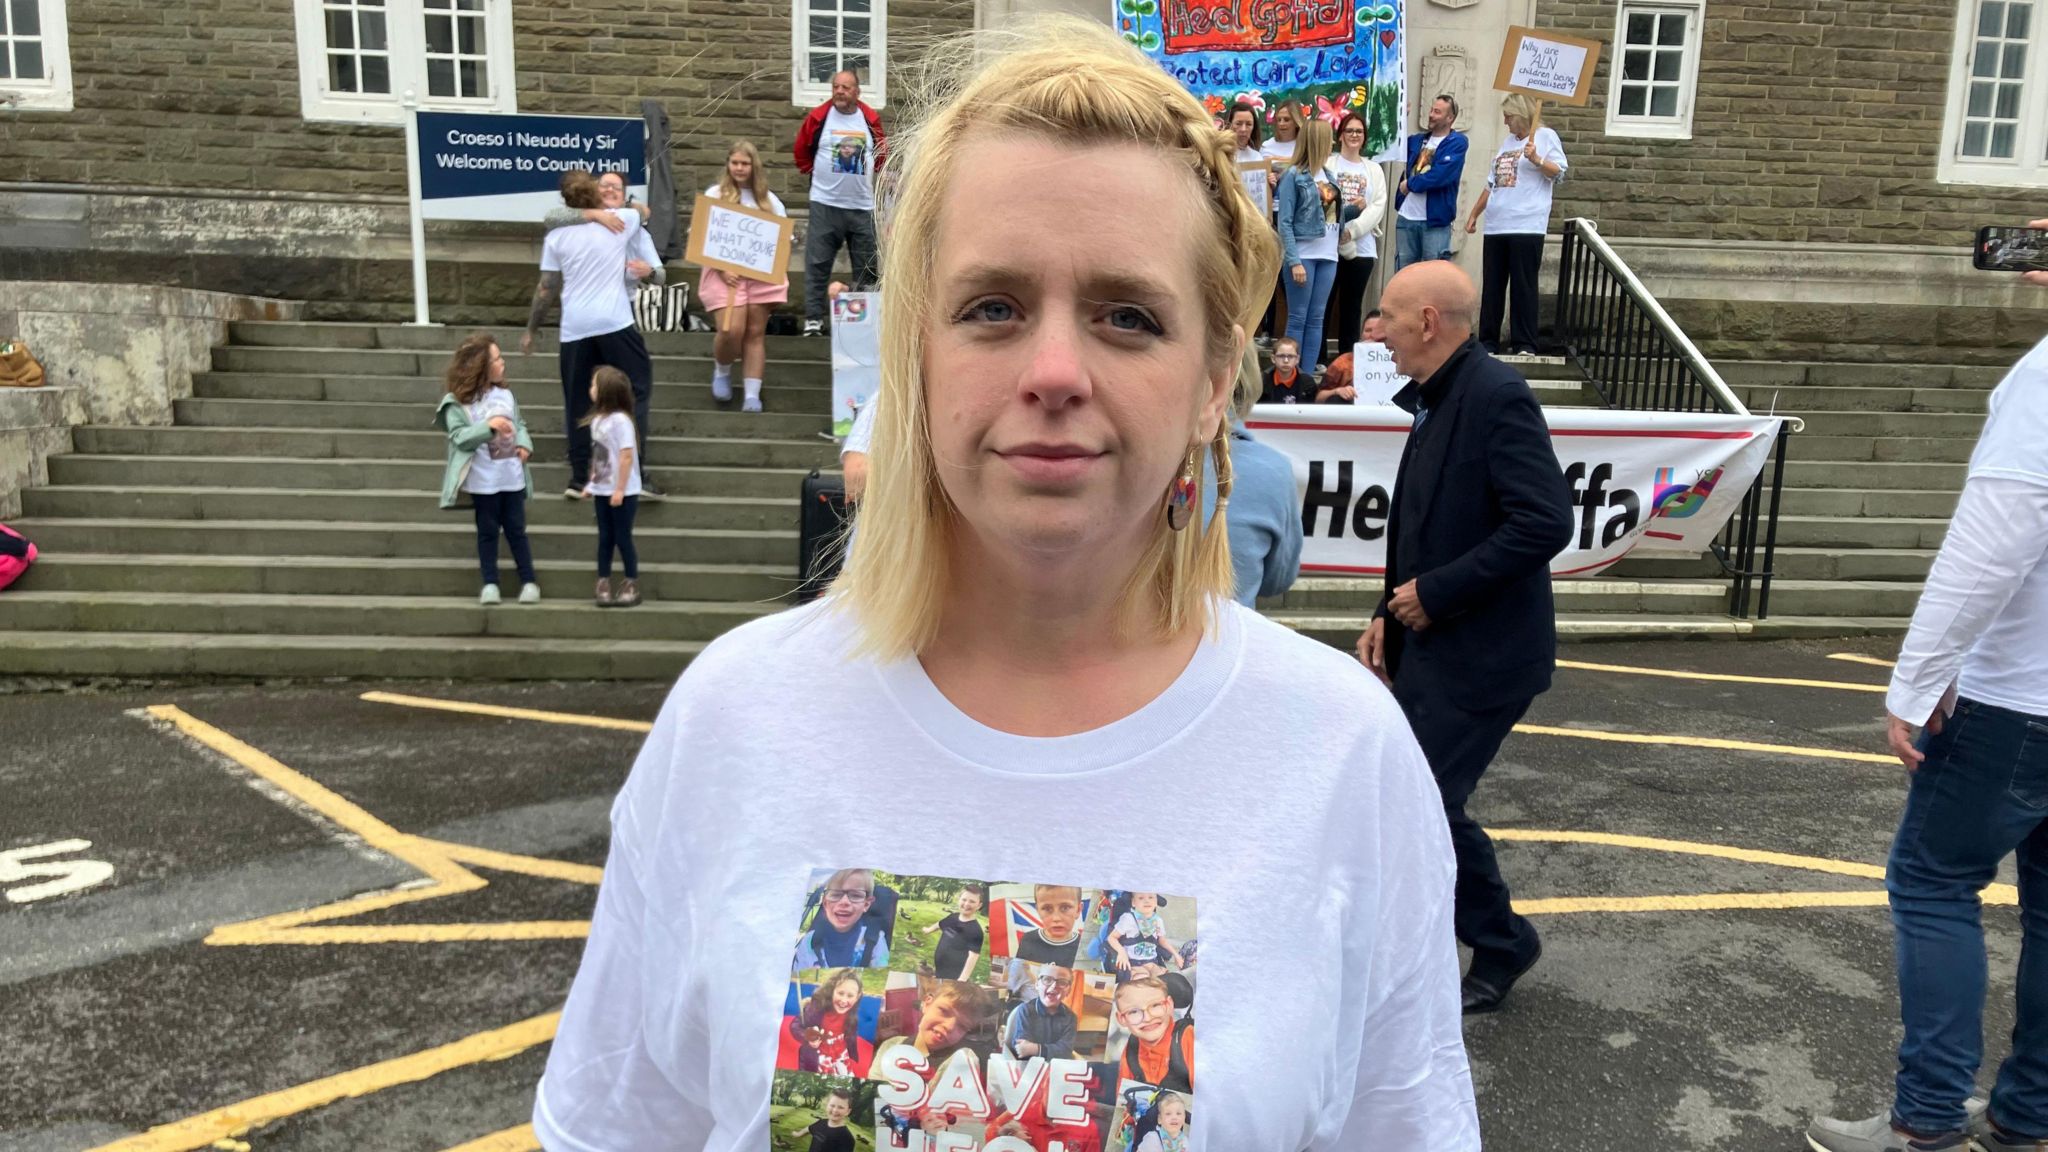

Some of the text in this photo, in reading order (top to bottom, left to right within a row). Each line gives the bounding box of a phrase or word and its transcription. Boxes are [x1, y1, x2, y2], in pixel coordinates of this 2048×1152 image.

[1521, 40, 1559, 58] Why are
[1313, 50, 1370, 81] Love
[1531, 54, 1558, 70] ALN
[1519, 67, 1575, 86] children being
[446, 130, 618, 153] Croeso i Neuadd y Sir
[435, 153, 629, 174] Welcome to County Hall
[711, 210, 764, 237] WE CCC
[708, 230, 745, 247] WHAT
[719, 245, 758, 266] DOING
[1368, 351, 1391, 362] Sha
[1365, 371, 1381, 381] on
[1301, 460, 1640, 550] He ffa
[877, 1044, 1093, 1127] SAVE
